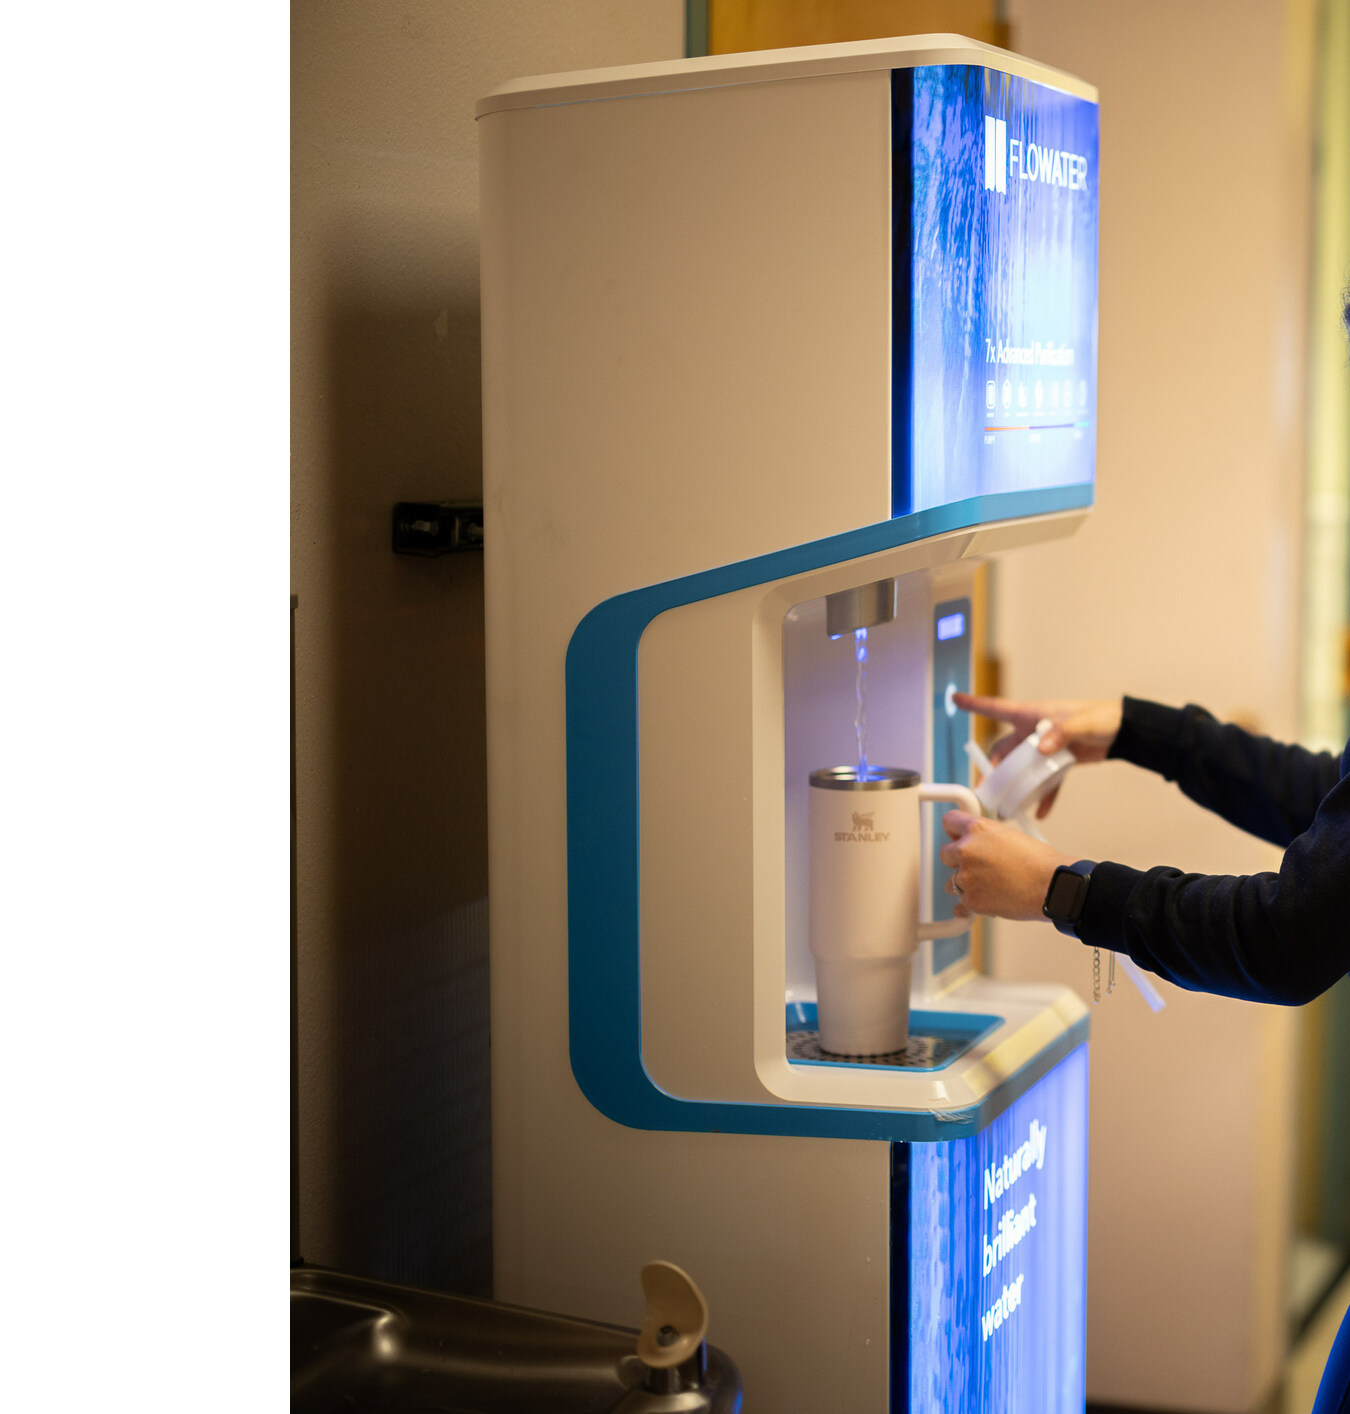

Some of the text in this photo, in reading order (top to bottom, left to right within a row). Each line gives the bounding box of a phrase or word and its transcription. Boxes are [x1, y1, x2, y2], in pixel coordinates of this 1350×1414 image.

[1009, 138, 1088, 191] FLOWATER
[986, 338, 996, 363] 7x
[834, 831, 890, 842] STANLEY
[983, 1118, 1047, 1210] Naturally
[982, 1192, 1037, 1277] brilliant
[981, 1273, 1024, 1342] water
